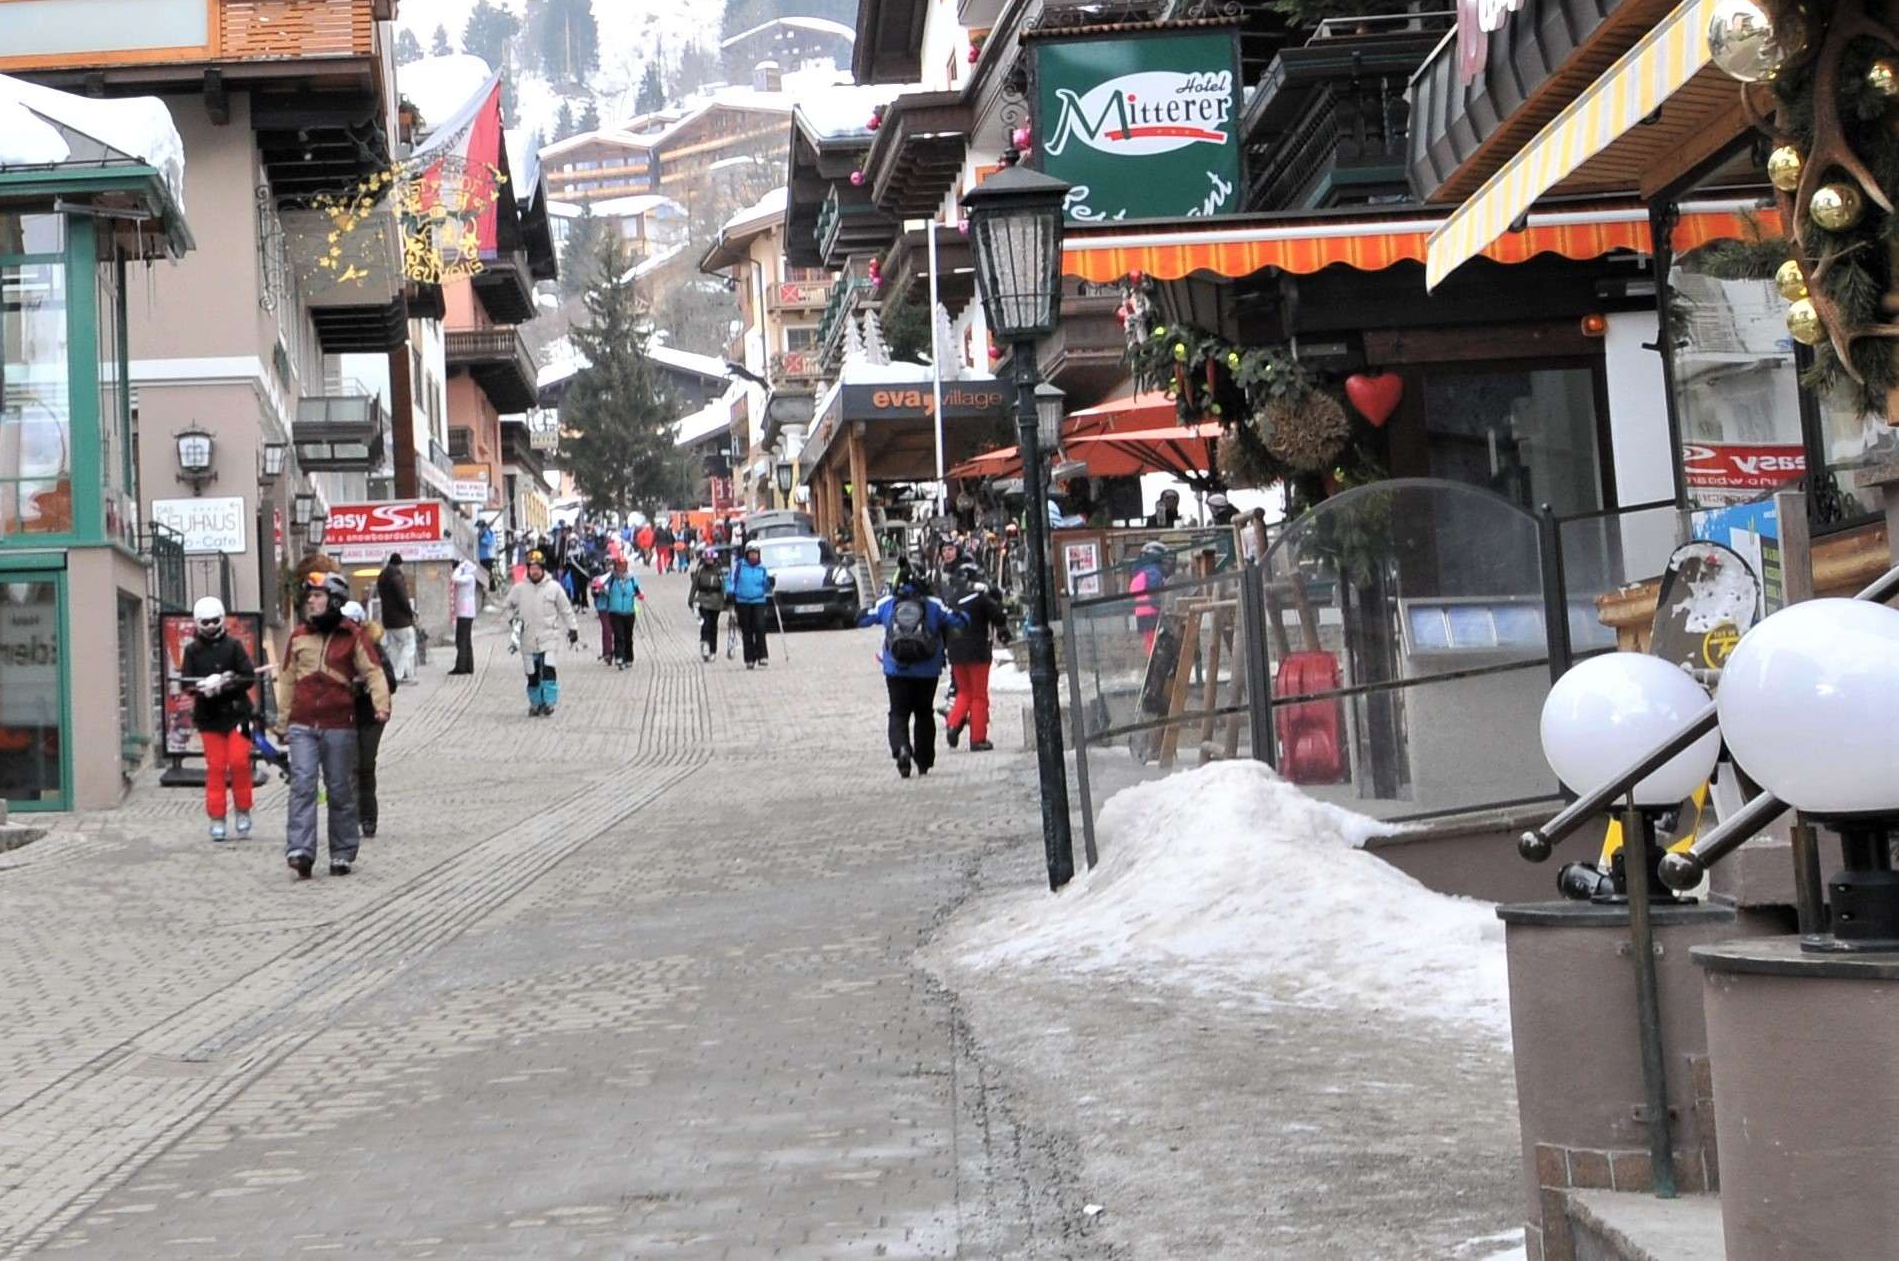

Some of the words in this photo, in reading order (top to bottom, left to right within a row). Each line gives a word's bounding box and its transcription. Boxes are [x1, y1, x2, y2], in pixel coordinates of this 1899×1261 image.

[1175, 76, 1227, 94] Hotel
[1049, 88, 1229, 150] Mitterer
[324, 511, 368, 531] easy
